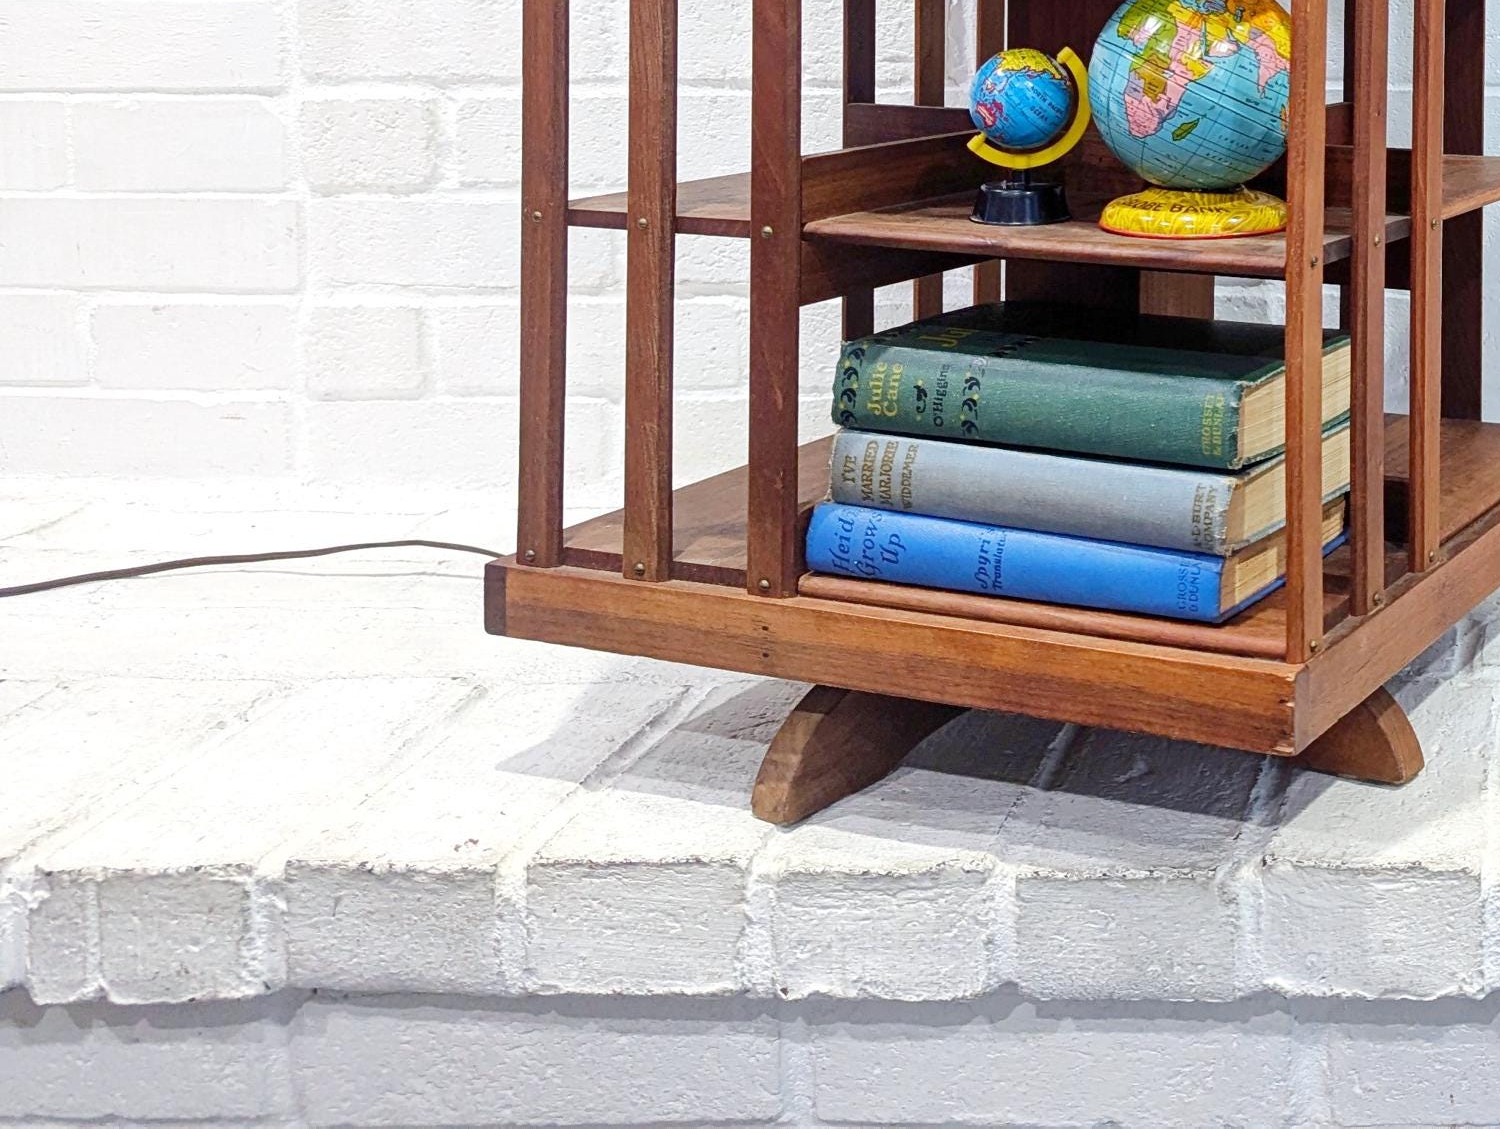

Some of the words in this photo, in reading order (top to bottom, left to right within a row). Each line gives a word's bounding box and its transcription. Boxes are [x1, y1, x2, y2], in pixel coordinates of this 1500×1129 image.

[1170, 203, 1231, 214] BANK
[867, 362, 887, 416] Julie
[882, 363, 903, 417] Cane
[932, 364, 951, 427] O'Higgins
[842, 454, 856, 484] I'VE
[861, 440, 879, 502] MARRIED
[879, 441, 899, 506] MARJORIE
[902, 444, 919, 509] WIDDEMER
[855, 512, 883, 577] Grows
[880, 533, 906, 565] Up
[1189, 562, 1201, 602] DUNLA
